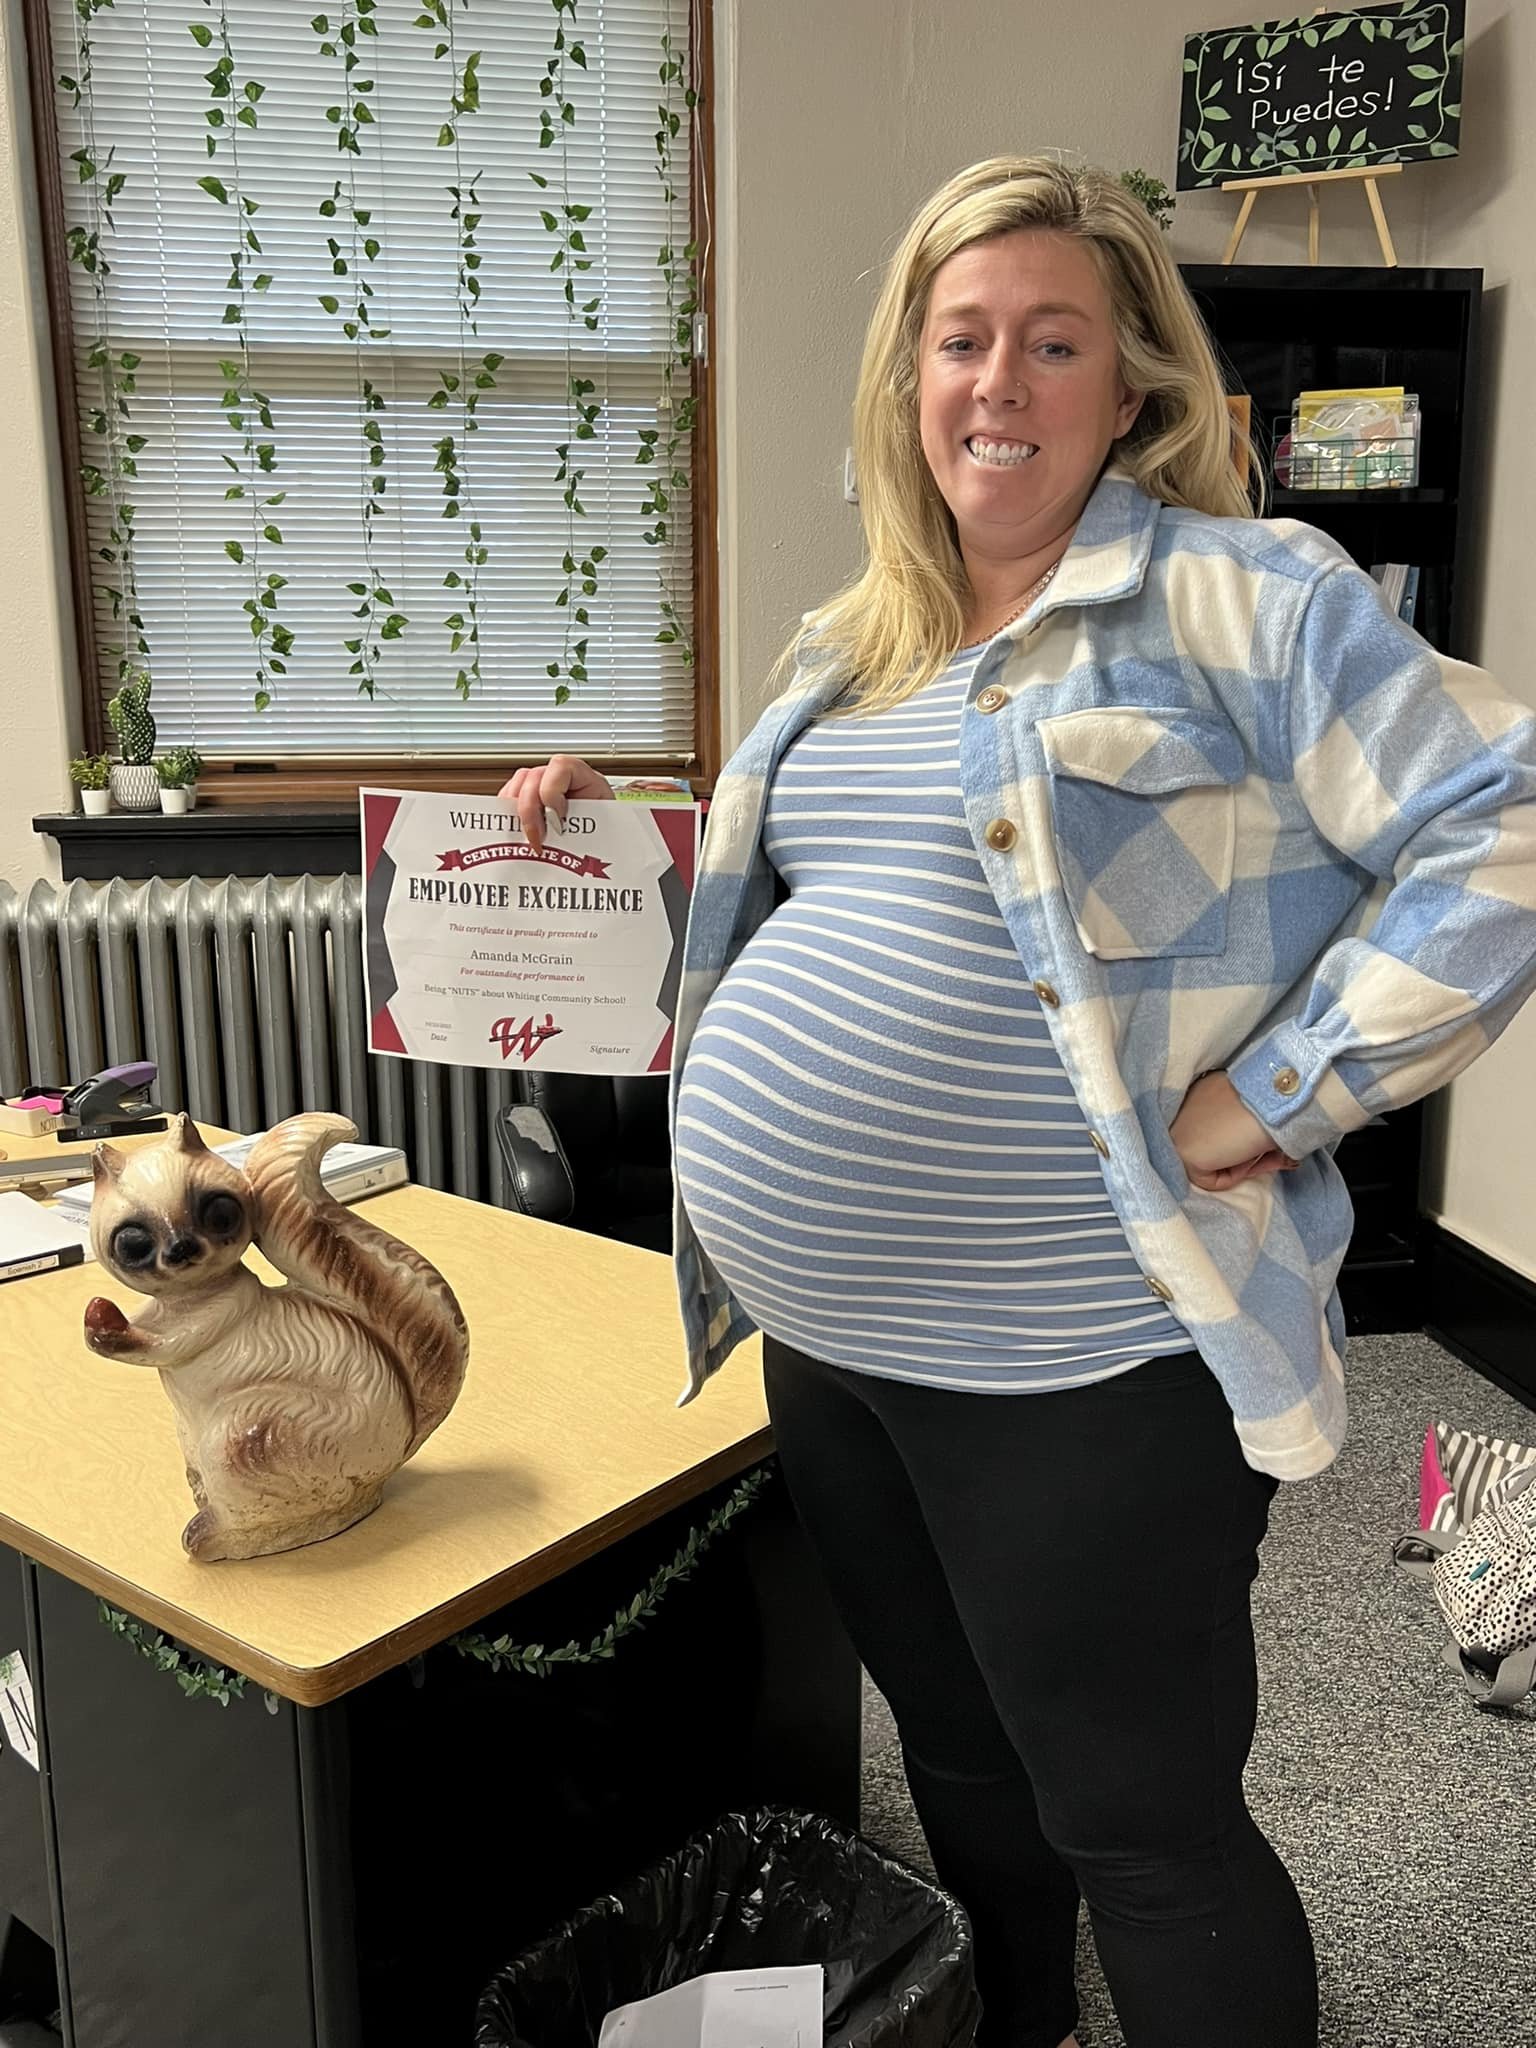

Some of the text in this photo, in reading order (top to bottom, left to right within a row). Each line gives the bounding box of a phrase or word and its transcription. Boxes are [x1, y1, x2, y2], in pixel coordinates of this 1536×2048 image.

[1318, 54, 1365, 84] te
[1251, 76, 1395, 129] Puedes!
[450, 811, 547, 833] WHITI
[561, 855, 582, 870] OF
[409, 877, 644, 914] EMPLOYEE EXCELLENCE
[449, 923, 599, 940] This certificate is proudly presented to
[470, 949, 574, 966] Amanda McGrain
[460, 966, 586, 983] For outstanding performance in
[424, 983, 447, 995] Being
[481, 988, 505, 999] about
[506, 990, 541, 1003] Whiting
[541, 993, 592, 1005] Community
[593, 995, 627, 1005] School!
[430, 1032, 449, 1042] Date
[589, 1044, 632, 1055] Signature
